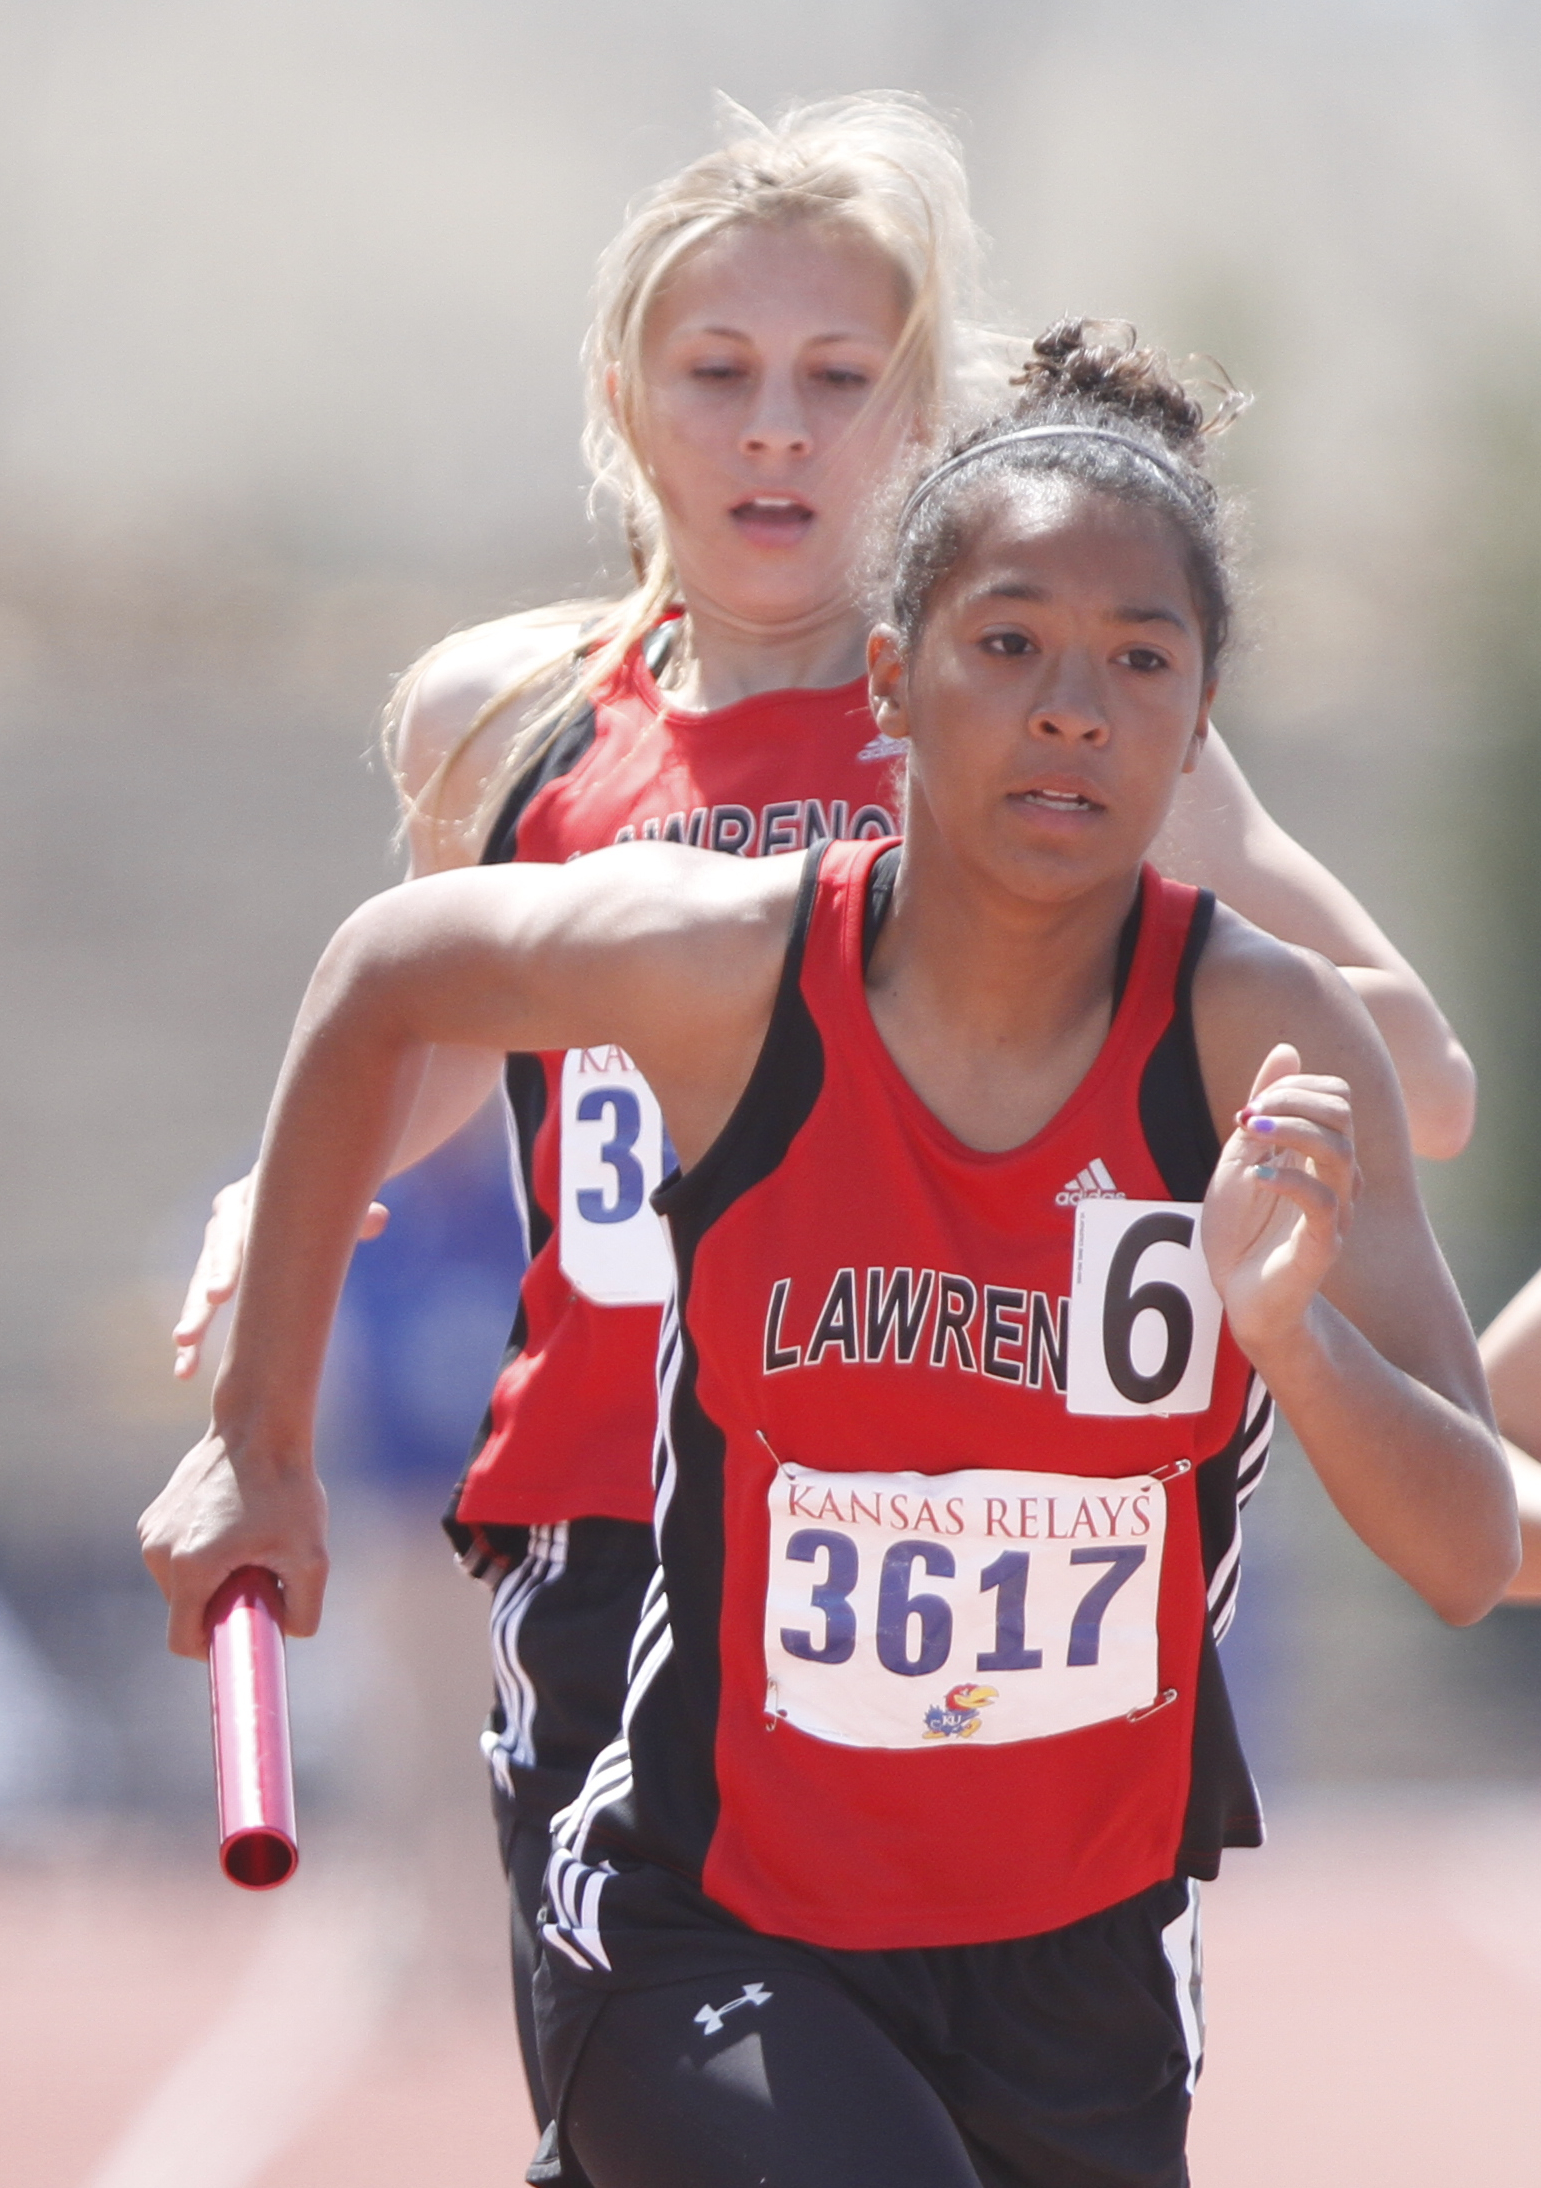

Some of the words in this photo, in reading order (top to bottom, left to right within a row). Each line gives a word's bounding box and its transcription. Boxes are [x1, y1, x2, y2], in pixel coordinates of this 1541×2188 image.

[1102, 1211, 1196, 1404] 6
[787, 1484, 965, 1536] KANSAS
[984, 1494, 1151, 1539] RELAYS
[779, 1528, 1148, 1677] 3617
[942, 1715, 962, 1726] KU
